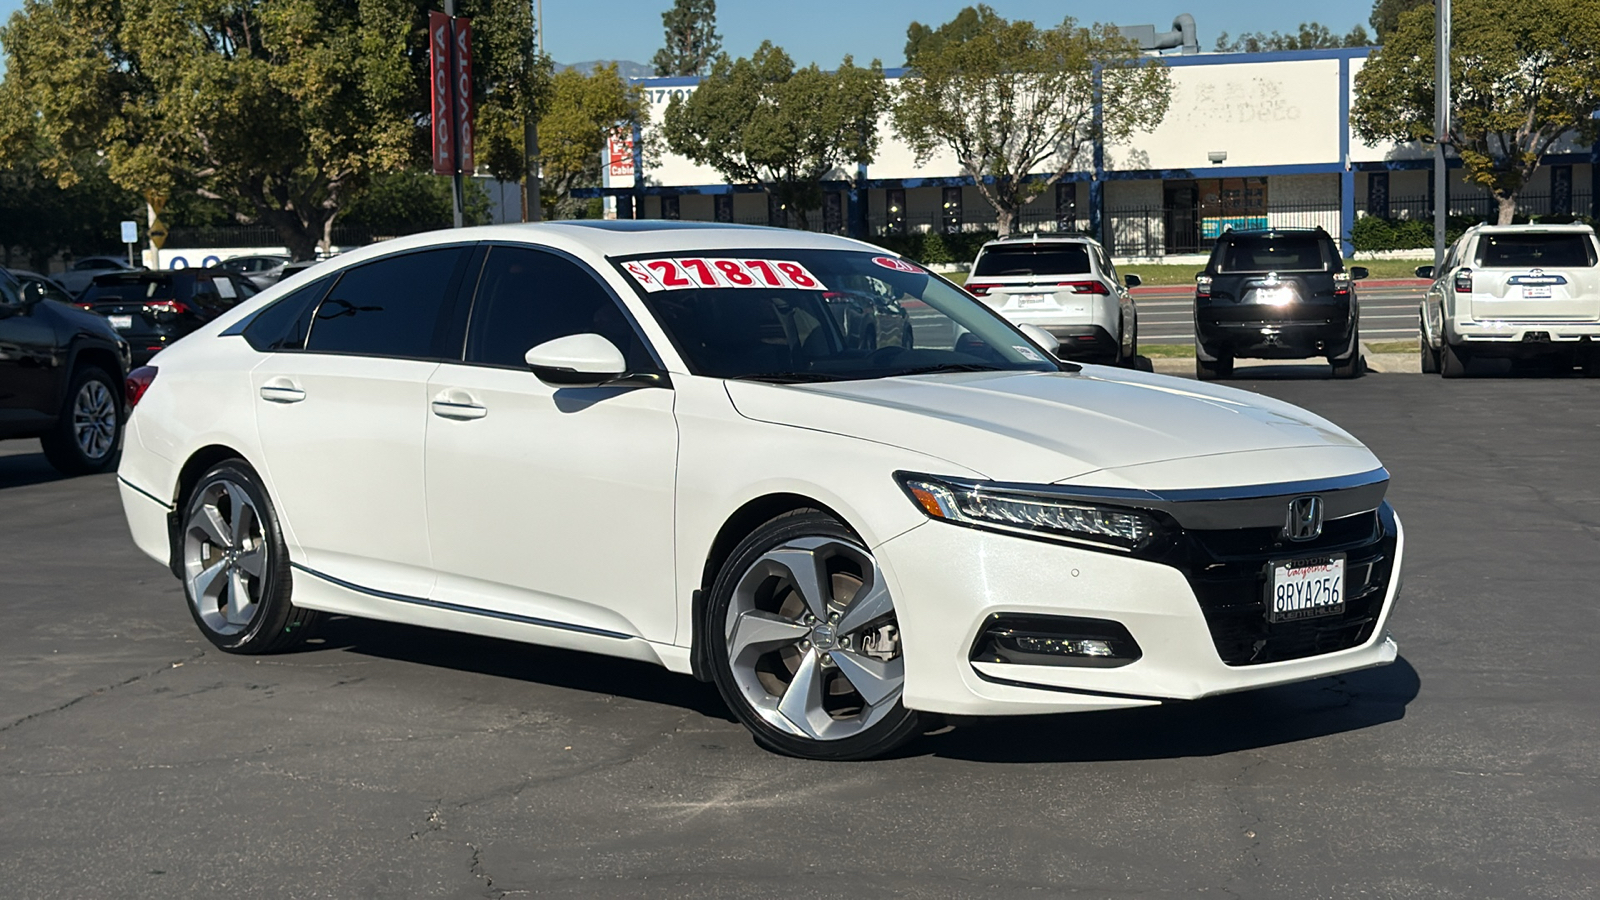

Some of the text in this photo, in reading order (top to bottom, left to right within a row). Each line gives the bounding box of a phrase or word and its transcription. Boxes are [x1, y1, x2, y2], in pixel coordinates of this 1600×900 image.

[435, 25, 449, 165] TOYOTA
[457, 29, 471, 164] TOYOTA
[628, 259, 819, 288] $27878
[1276, 576, 1341, 611] 8RYA256
